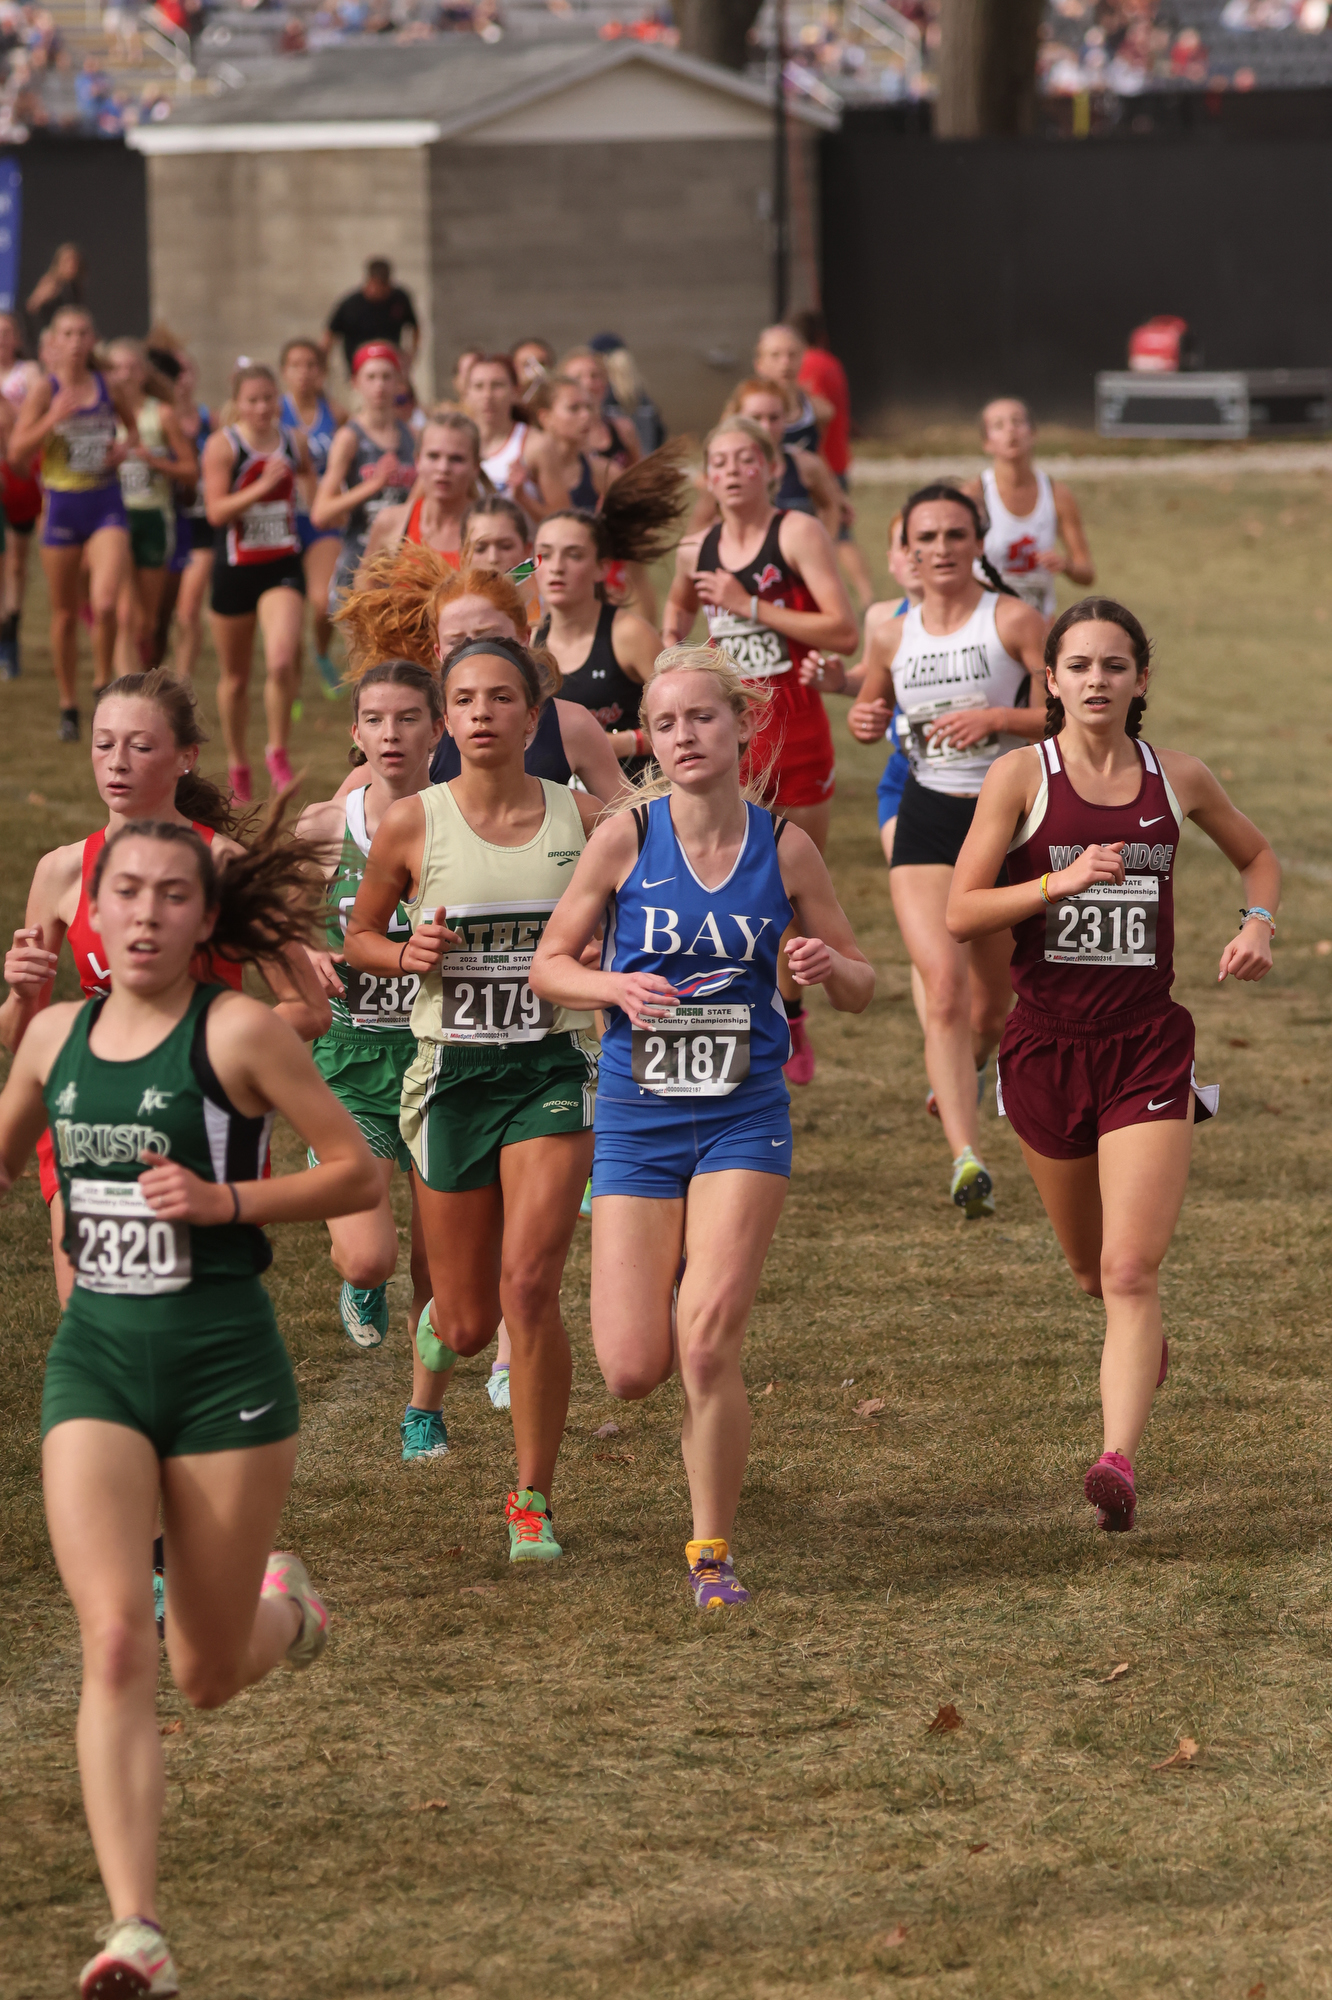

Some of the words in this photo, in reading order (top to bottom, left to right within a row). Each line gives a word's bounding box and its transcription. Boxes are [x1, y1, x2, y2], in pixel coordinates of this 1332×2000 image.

[903, 645, 991, 689] CARROLLTON
[547, 850, 581, 858] BROOKS
[1102, 887, 1157, 896] Championships
[640, 906, 773, 962] BAY
[1057, 905, 1147, 950] 2316
[465, 964, 495, 973] Country
[454, 983, 541, 1026] 2179
[675, 1007, 704, 1016] OHSAA
[657, 1017, 689, 1025] Country
[690, 1017, 748, 1025] Championships
[644, 1036, 737, 1080] 2187
[542, 1100, 580, 1109] BROOKS
[78, 1216, 177, 1276] 2320
